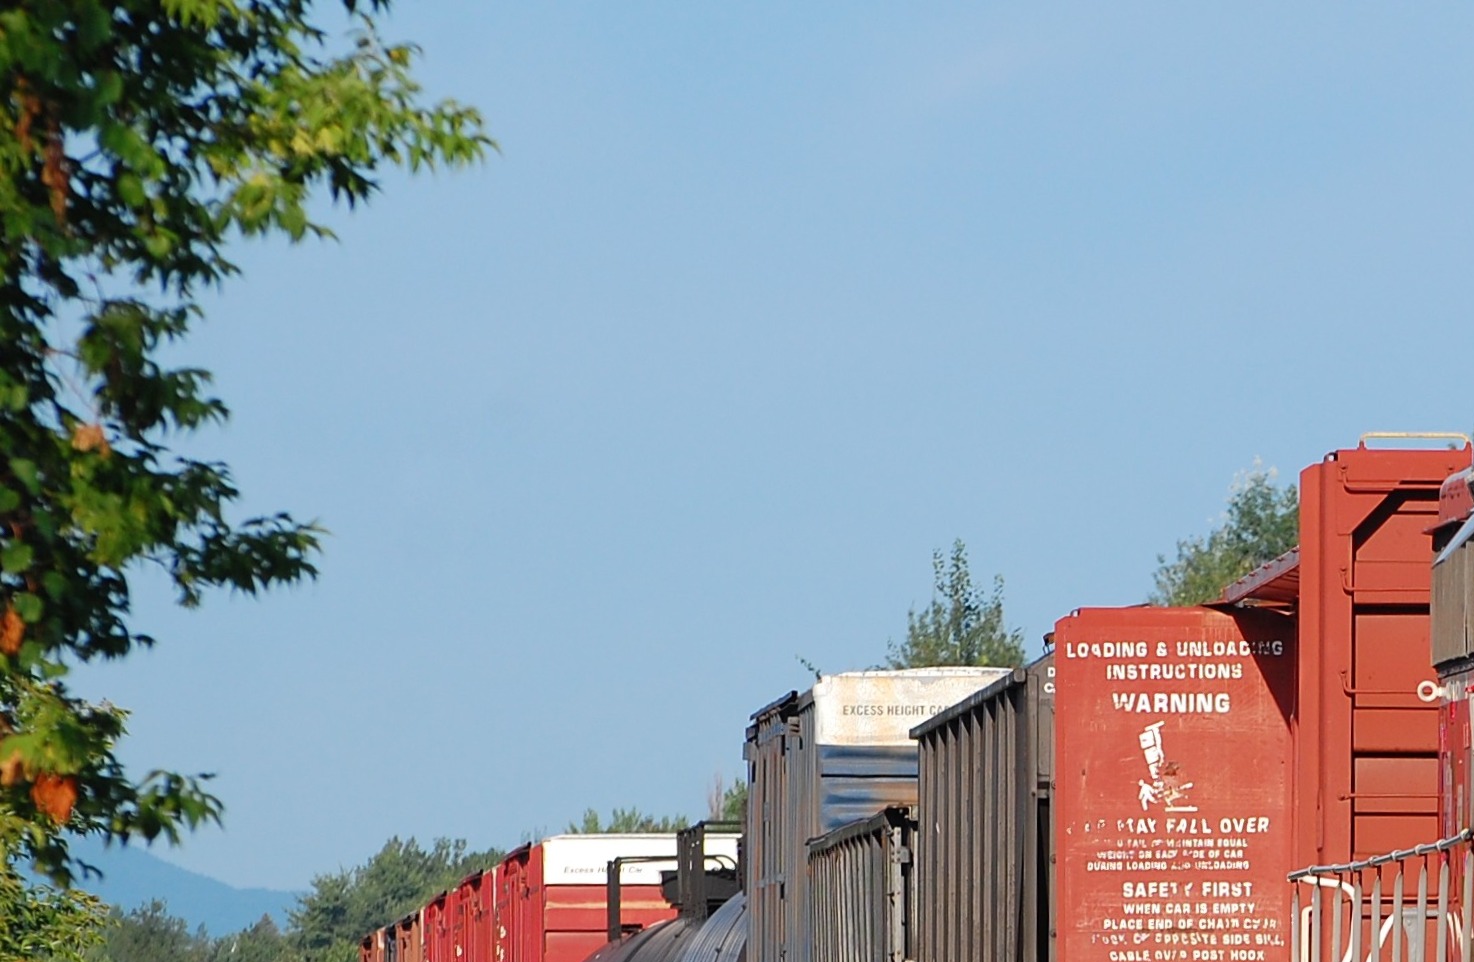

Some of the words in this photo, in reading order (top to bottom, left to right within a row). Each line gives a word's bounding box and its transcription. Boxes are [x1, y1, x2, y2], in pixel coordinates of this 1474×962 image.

[1066, 642, 1148, 659] LOADING
[1156, 642, 1168, 658] &
[1106, 663, 1243, 680] INSTRUCTIONS
[1112, 692, 1231, 714] WARNING
[842, 704, 884, 716] EXCESS
[887, 704, 926, 716] HEIGHT
[1166, 818, 1212, 834] FALL
[1220, 816, 1270, 834] OVER
[1223, 849, 1244, 859] CAR
[1086, 862, 1123, 872] DURING
[1126, 862, 1168, 871] LOADING
[1122, 881, 1194, 898] SAFETY
[1201, 881, 1253, 898] FIRST
[1123, 903, 1161, 914] WHEN
[1165, 903, 1191, 914] CAR
[1195, 903, 1208, 914] IS
[1212, 903, 1256, 914] EMPTY
[1103, 919, 1143, 930] PLACE
[1147, 919, 1173, 930] END
[1178, 919, 1194, 930] OF
[1222, 933, 1251, 945] SIDE
[1109, 949, 1151, 962] CABLE
[1192, 949, 1225, 961] POST
